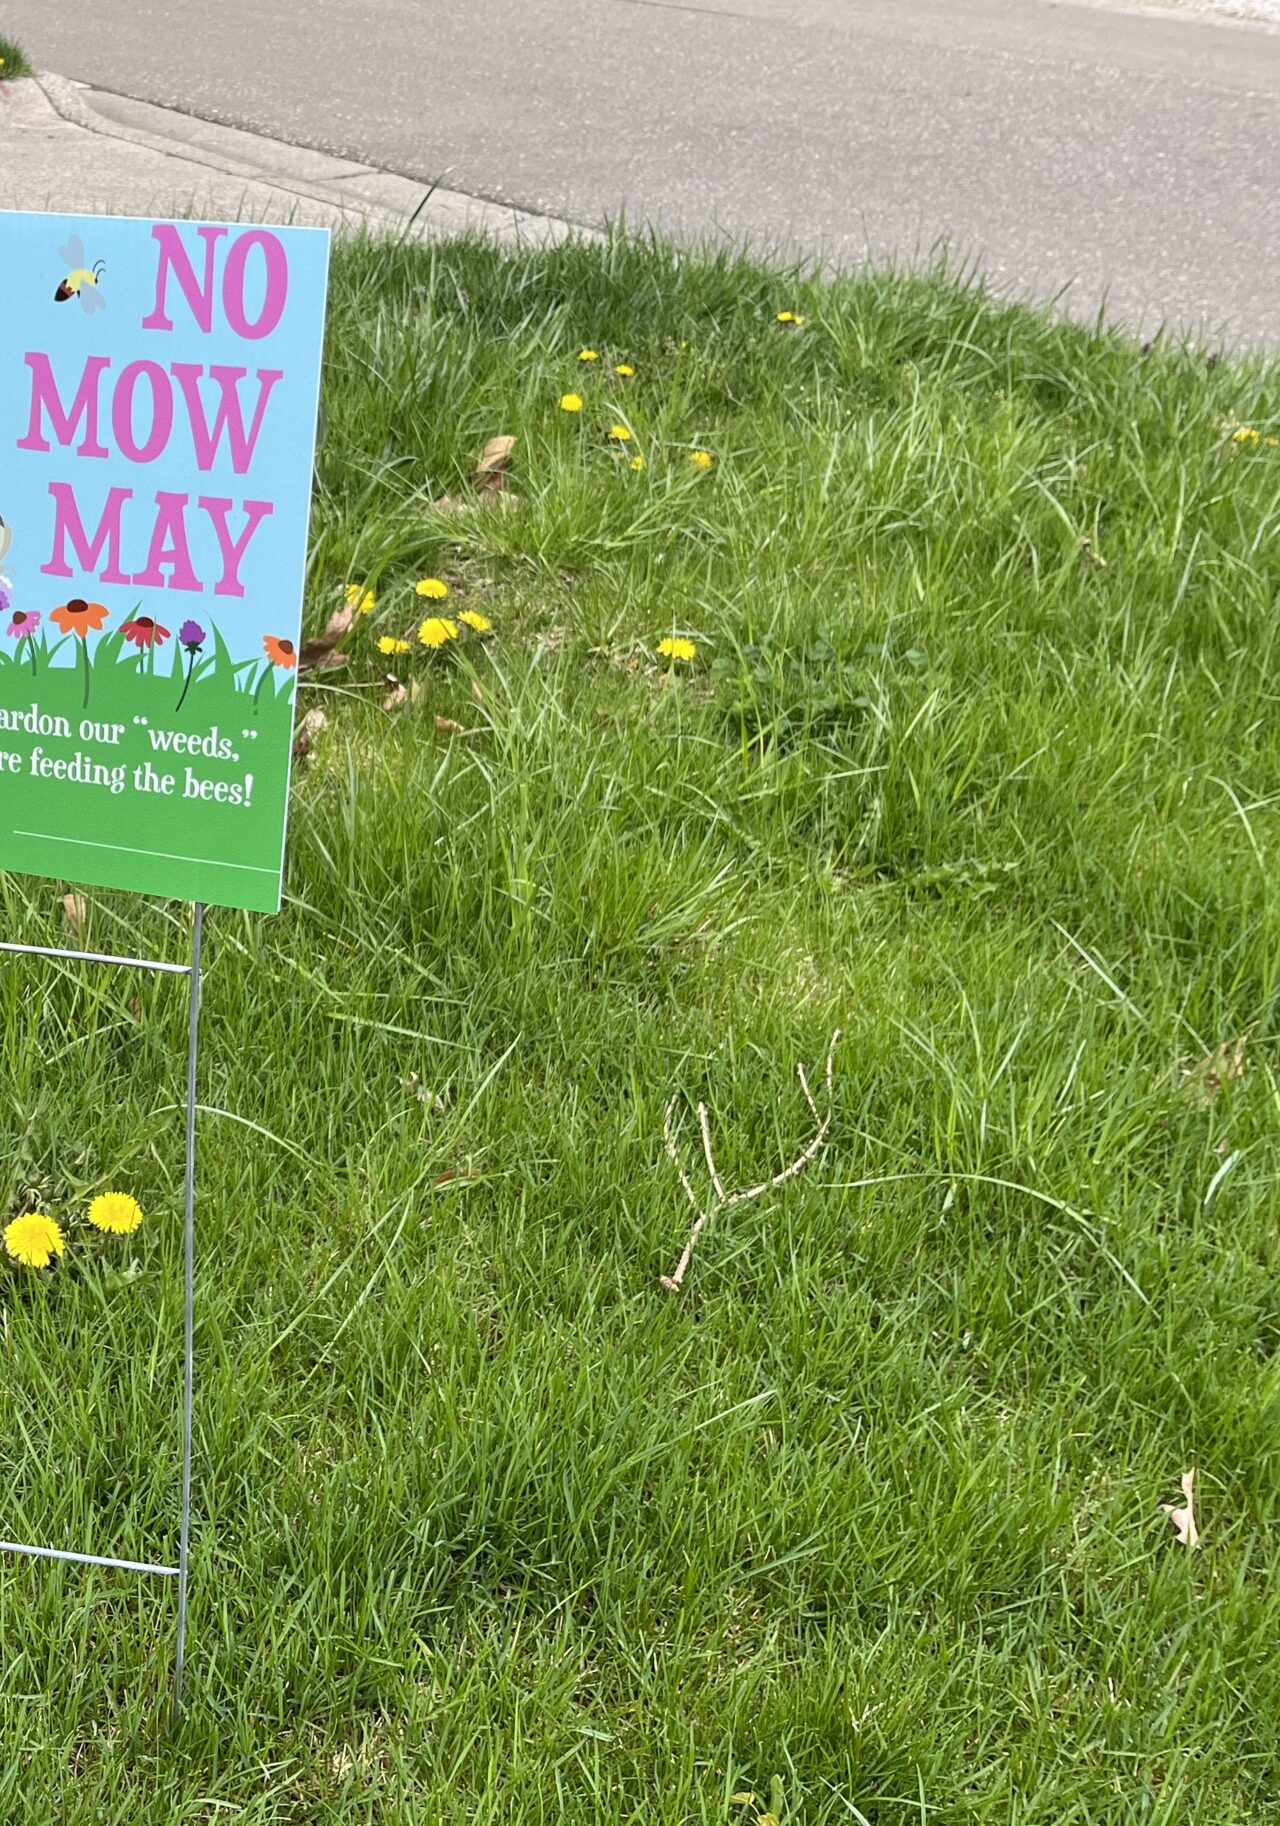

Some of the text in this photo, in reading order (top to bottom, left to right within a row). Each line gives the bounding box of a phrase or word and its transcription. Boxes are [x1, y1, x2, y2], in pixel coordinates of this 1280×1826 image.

[142, 224, 288, 340] NO
[16, 351, 284, 474] MOW
[40, 481, 273, 598] MAY
[29, 746, 126, 794] feeding
[132, 762, 175, 795] the
[182, 767, 254, 808] bees!
[79, 719, 125, 745] our
